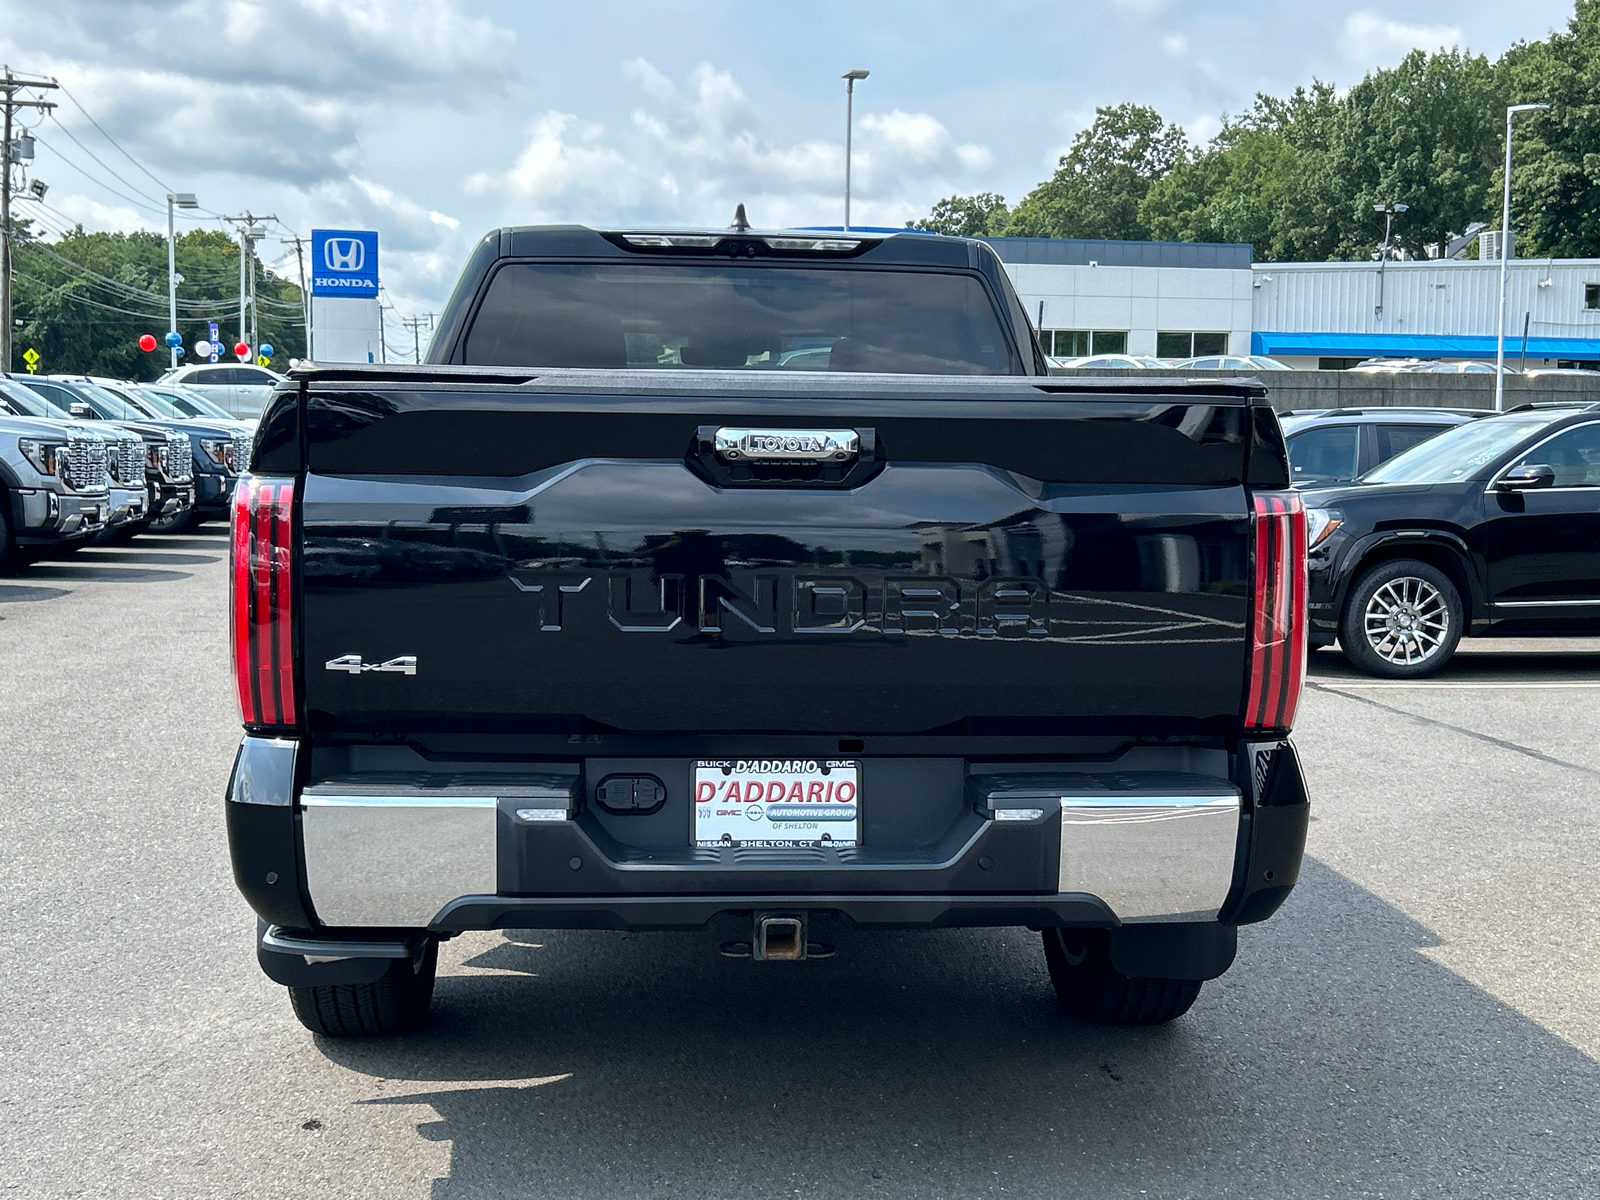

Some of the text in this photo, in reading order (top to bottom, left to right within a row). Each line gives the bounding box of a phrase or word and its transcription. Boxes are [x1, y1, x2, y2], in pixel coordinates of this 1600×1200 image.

[315, 278, 375, 288] HONDA
[754, 436, 820, 451] TOYOTA
[509, 574, 1049, 635] TUNDRA
[325, 654, 417, 675] 4x4
[735, 760, 818, 774] D'ADDARIO
[826, 760, 855, 768] GMC
[695, 780, 856, 803] D'ADDARIO
[770, 808, 824, 817] AUTOMOTIVE
[825, 808, 853, 817] GROUP
